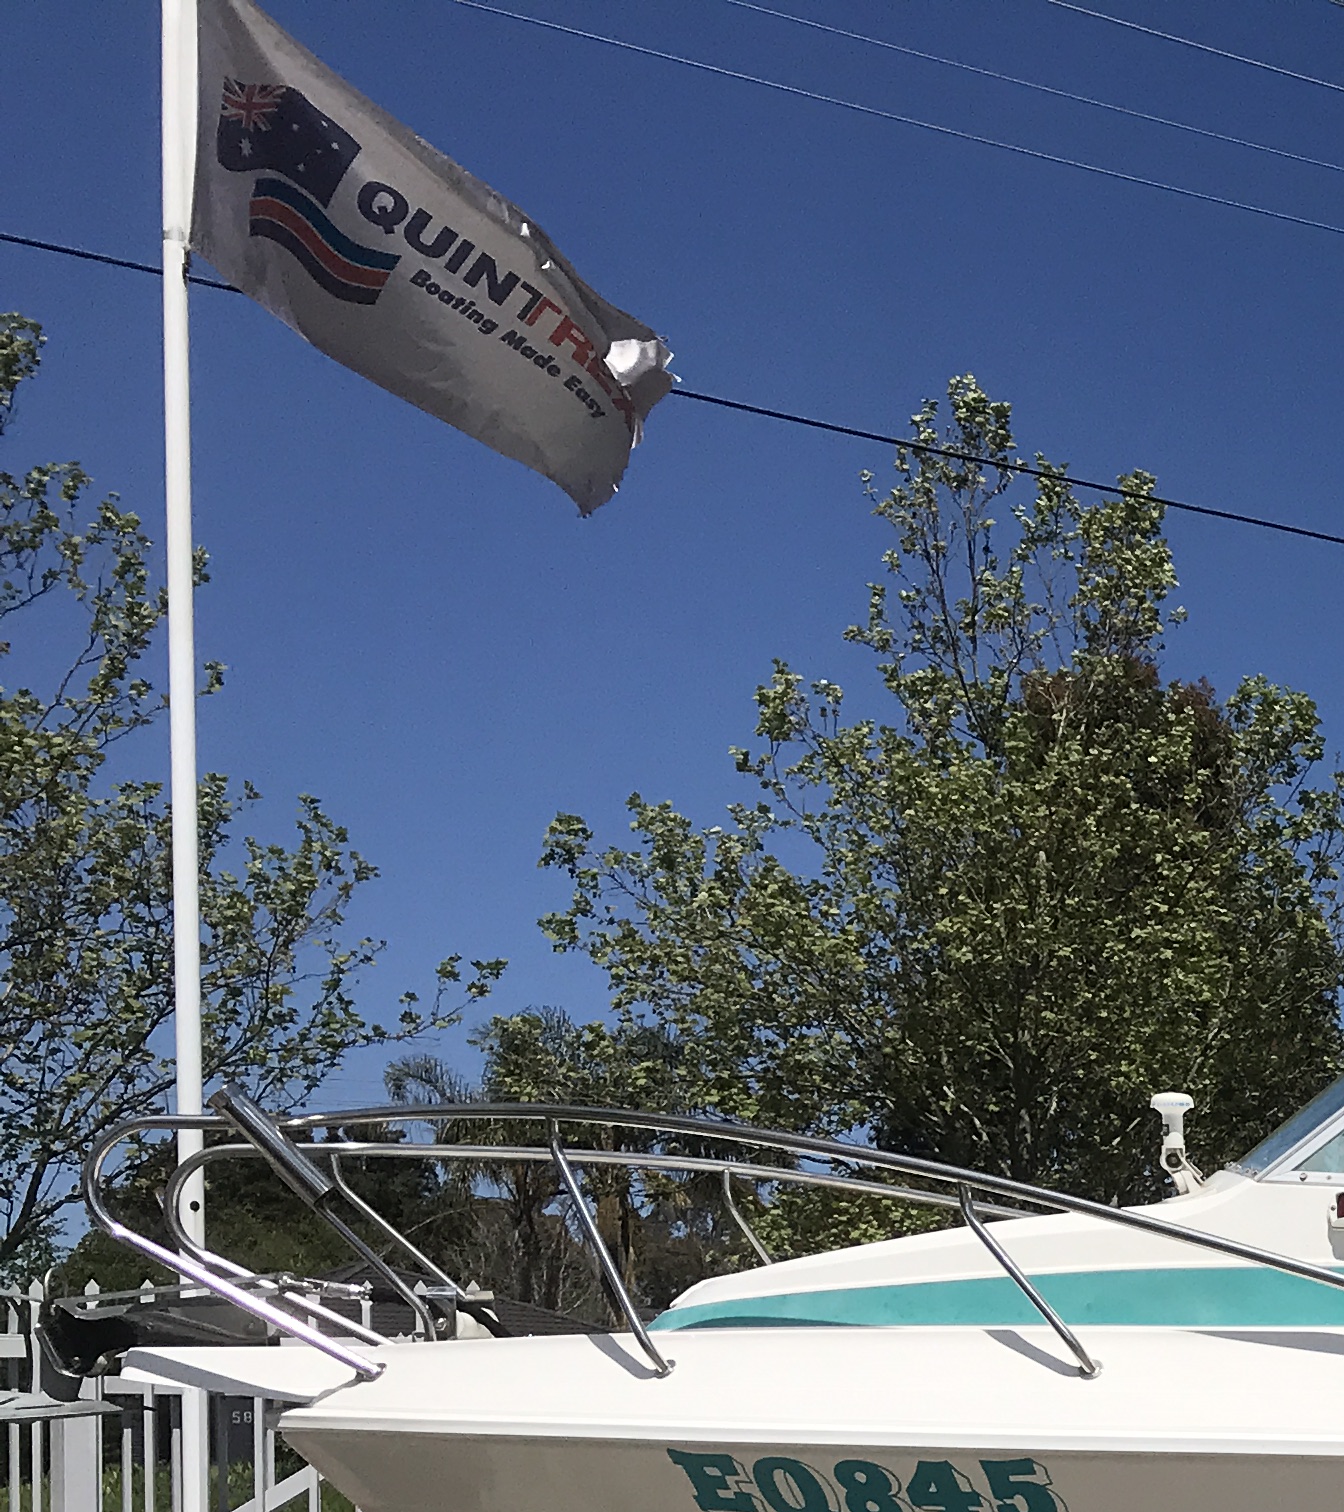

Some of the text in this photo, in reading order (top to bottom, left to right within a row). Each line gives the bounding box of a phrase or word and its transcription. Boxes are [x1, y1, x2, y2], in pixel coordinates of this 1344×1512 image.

[409, 268, 606, 418] Boating Made Easy
[231, 1410, 252, 1424] 58
